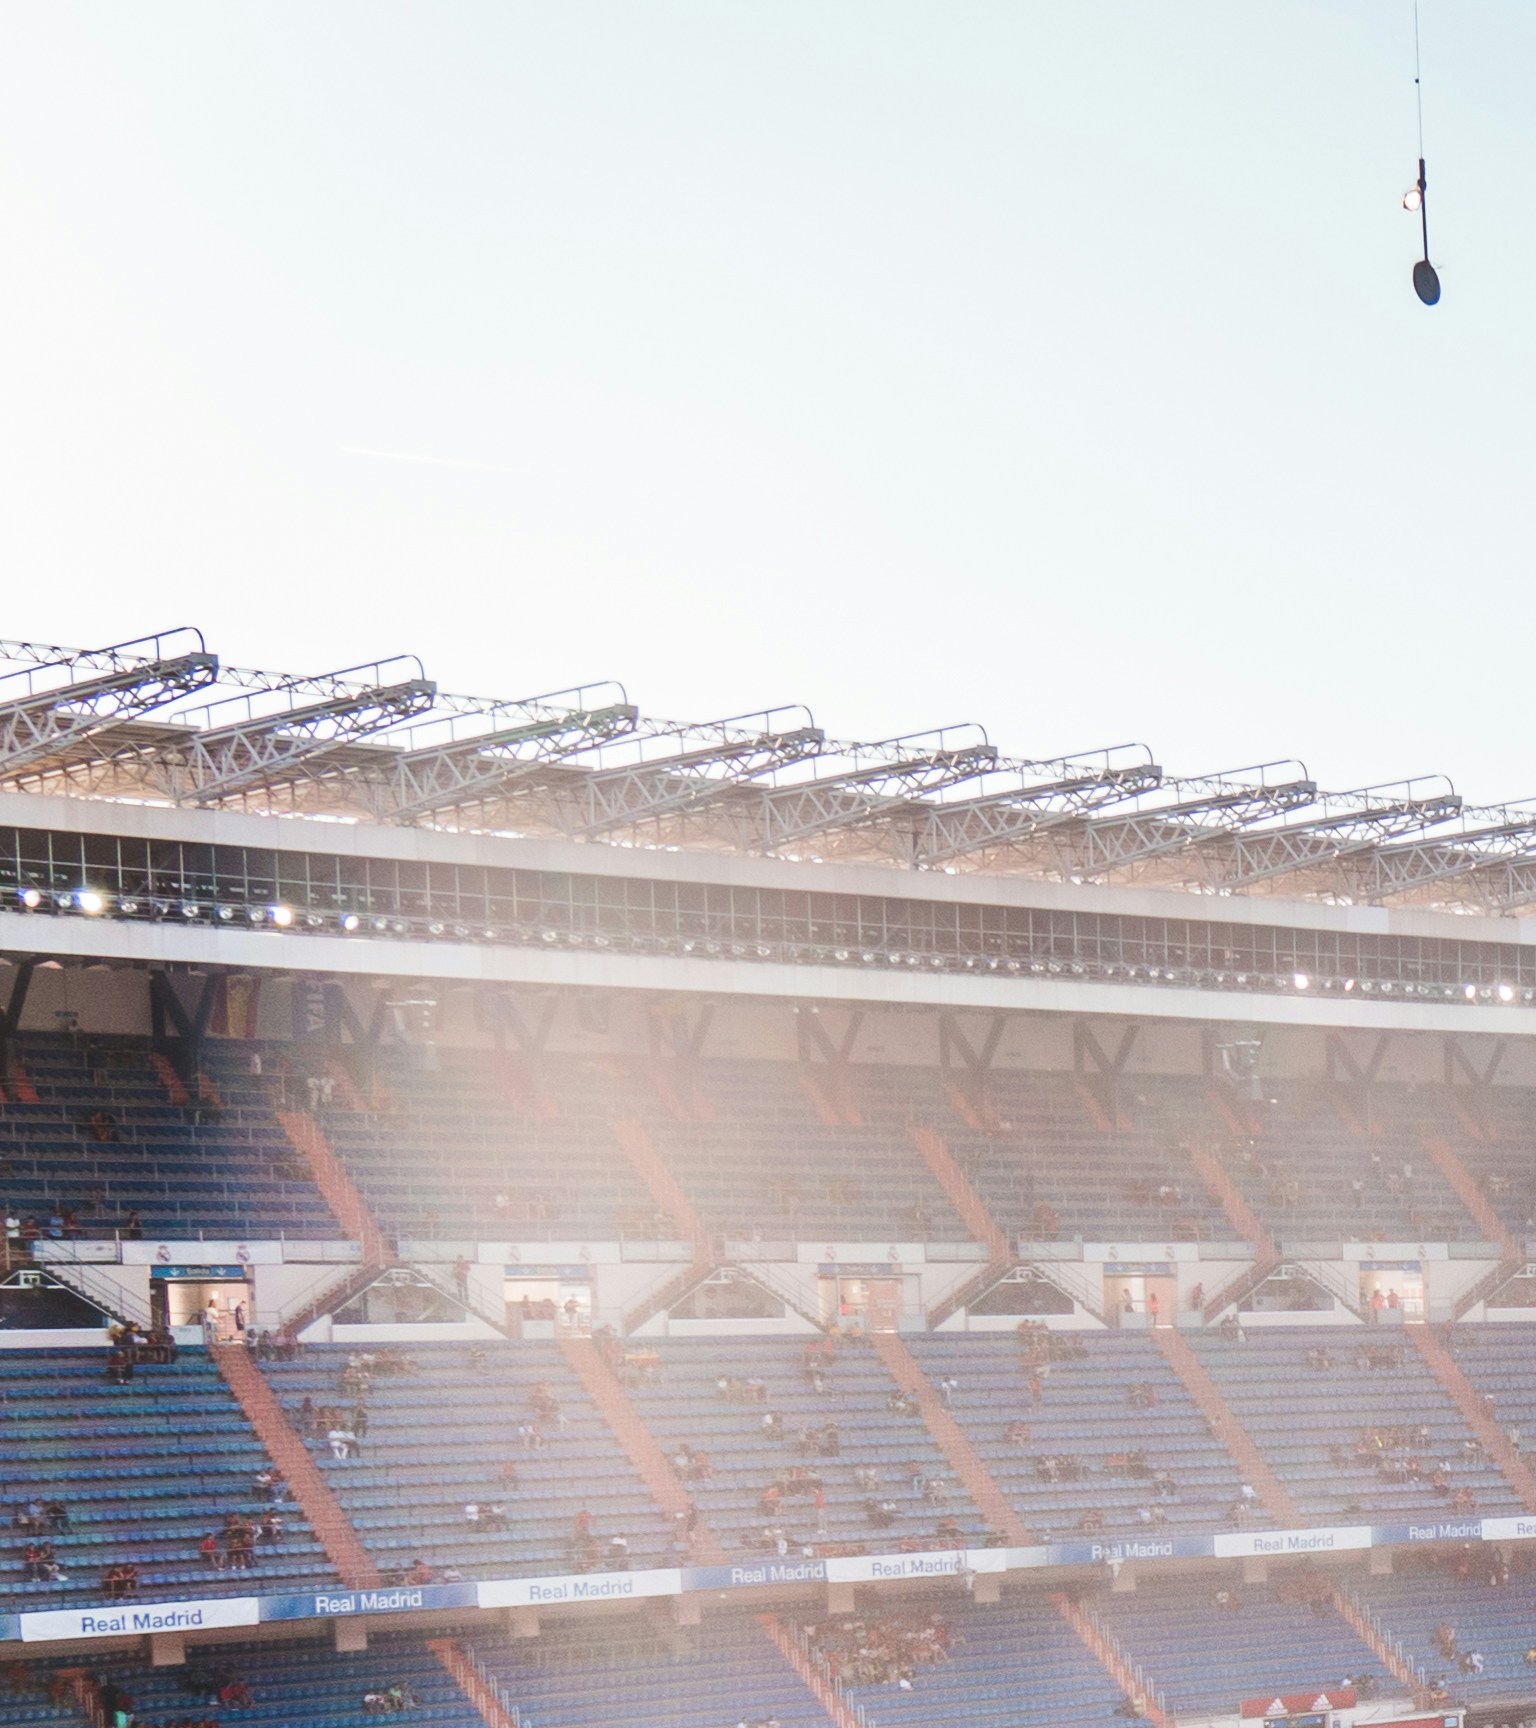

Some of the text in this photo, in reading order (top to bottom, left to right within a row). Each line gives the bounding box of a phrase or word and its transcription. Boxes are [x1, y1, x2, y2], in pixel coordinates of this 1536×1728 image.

[1409, 1524, 1480, 1539] Real Madrid
[1092, 1543, 1172, 1559] Real Madrid
[1254, 1535, 1334, 1551] Real Madrid
[732, 1564, 824, 1583] Real Madrid
[872, 1562, 908, 1576] Real
[529, 1580, 633, 1599] Real Madrid
[316, 1592, 422, 1612] Real Madrid
[81, 1610, 203, 1632] Real Madrid
